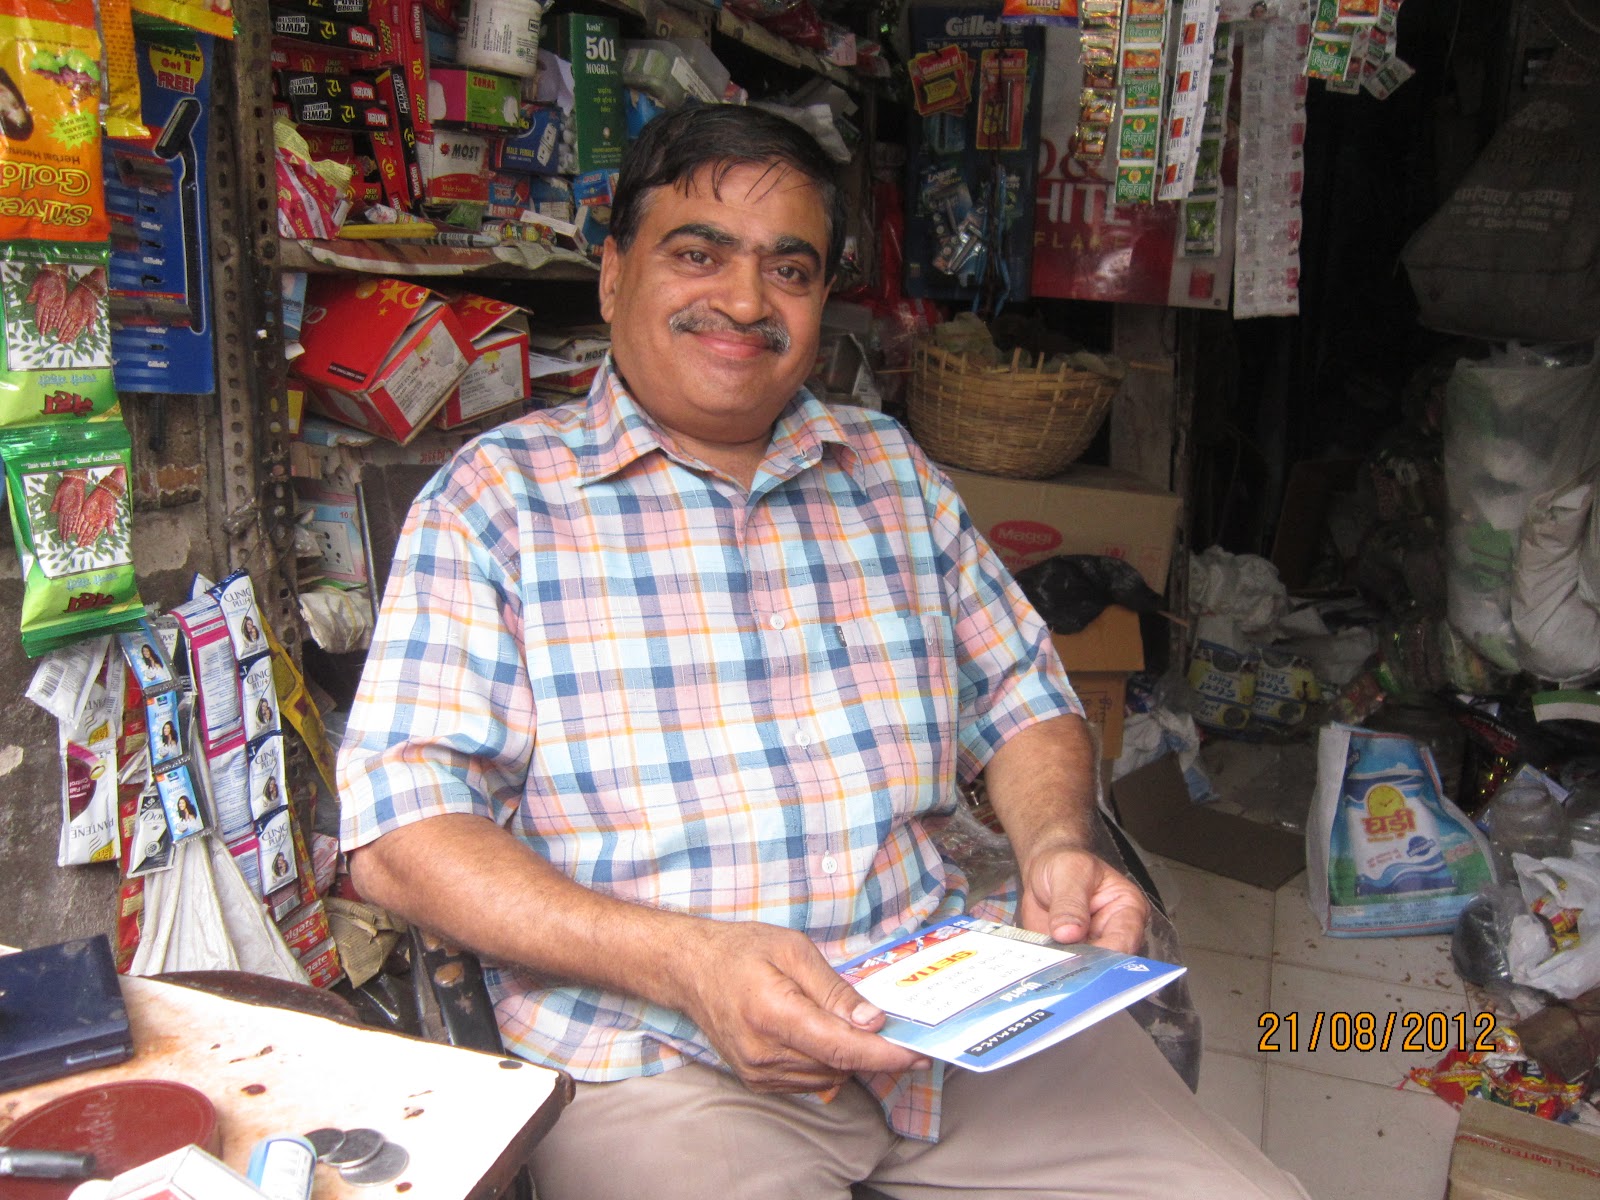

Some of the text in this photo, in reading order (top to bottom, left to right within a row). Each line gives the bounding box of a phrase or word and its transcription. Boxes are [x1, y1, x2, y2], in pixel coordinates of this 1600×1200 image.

[276, 23, 309, 35] POWER
[412, 5, 421, 39] Mortein
[945, 15, 1022, 36] Gillete
[350, 30, 374, 47] Mortein
[174, 48, 201, 62] Presto
[585, 36, 616, 62] 501
[585, 62, 610, 75] MOGRA
[157, 70, 196, 95] FREE!
[289, 83, 318, 95] POWER
[353, 85, 374, 99] Mortein
[302, 109, 332, 121] POWER
[367, 111, 388, 125] Mortein
[451, 143, 480, 160] MOST
[410, 166, 420, 196] Mortein
[0, 198, 93, 227] Silve
[998, 528, 1053, 545] Maggi
[224, 587, 252, 602] CLINIC
[247, 668, 271, 685] CLINIC
[255, 749, 279, 765] CLINIC
[69, 777, 89, 787] Control
[143, 811, 164, 822] Dov
[1362, 808, 1416, 839] घड़ी
[71, 817, 115, 839] PANTENE
[262, 823, 288, 841] CLINIC
[284, 917, 315, 941] olgate
[305, 955, 328, 975] gate
[902, 951, 974, 982] SETIA
[971, 1009, 1047, 1053] classmate
[1501, 1143, 1563, 1171] LIMITED
